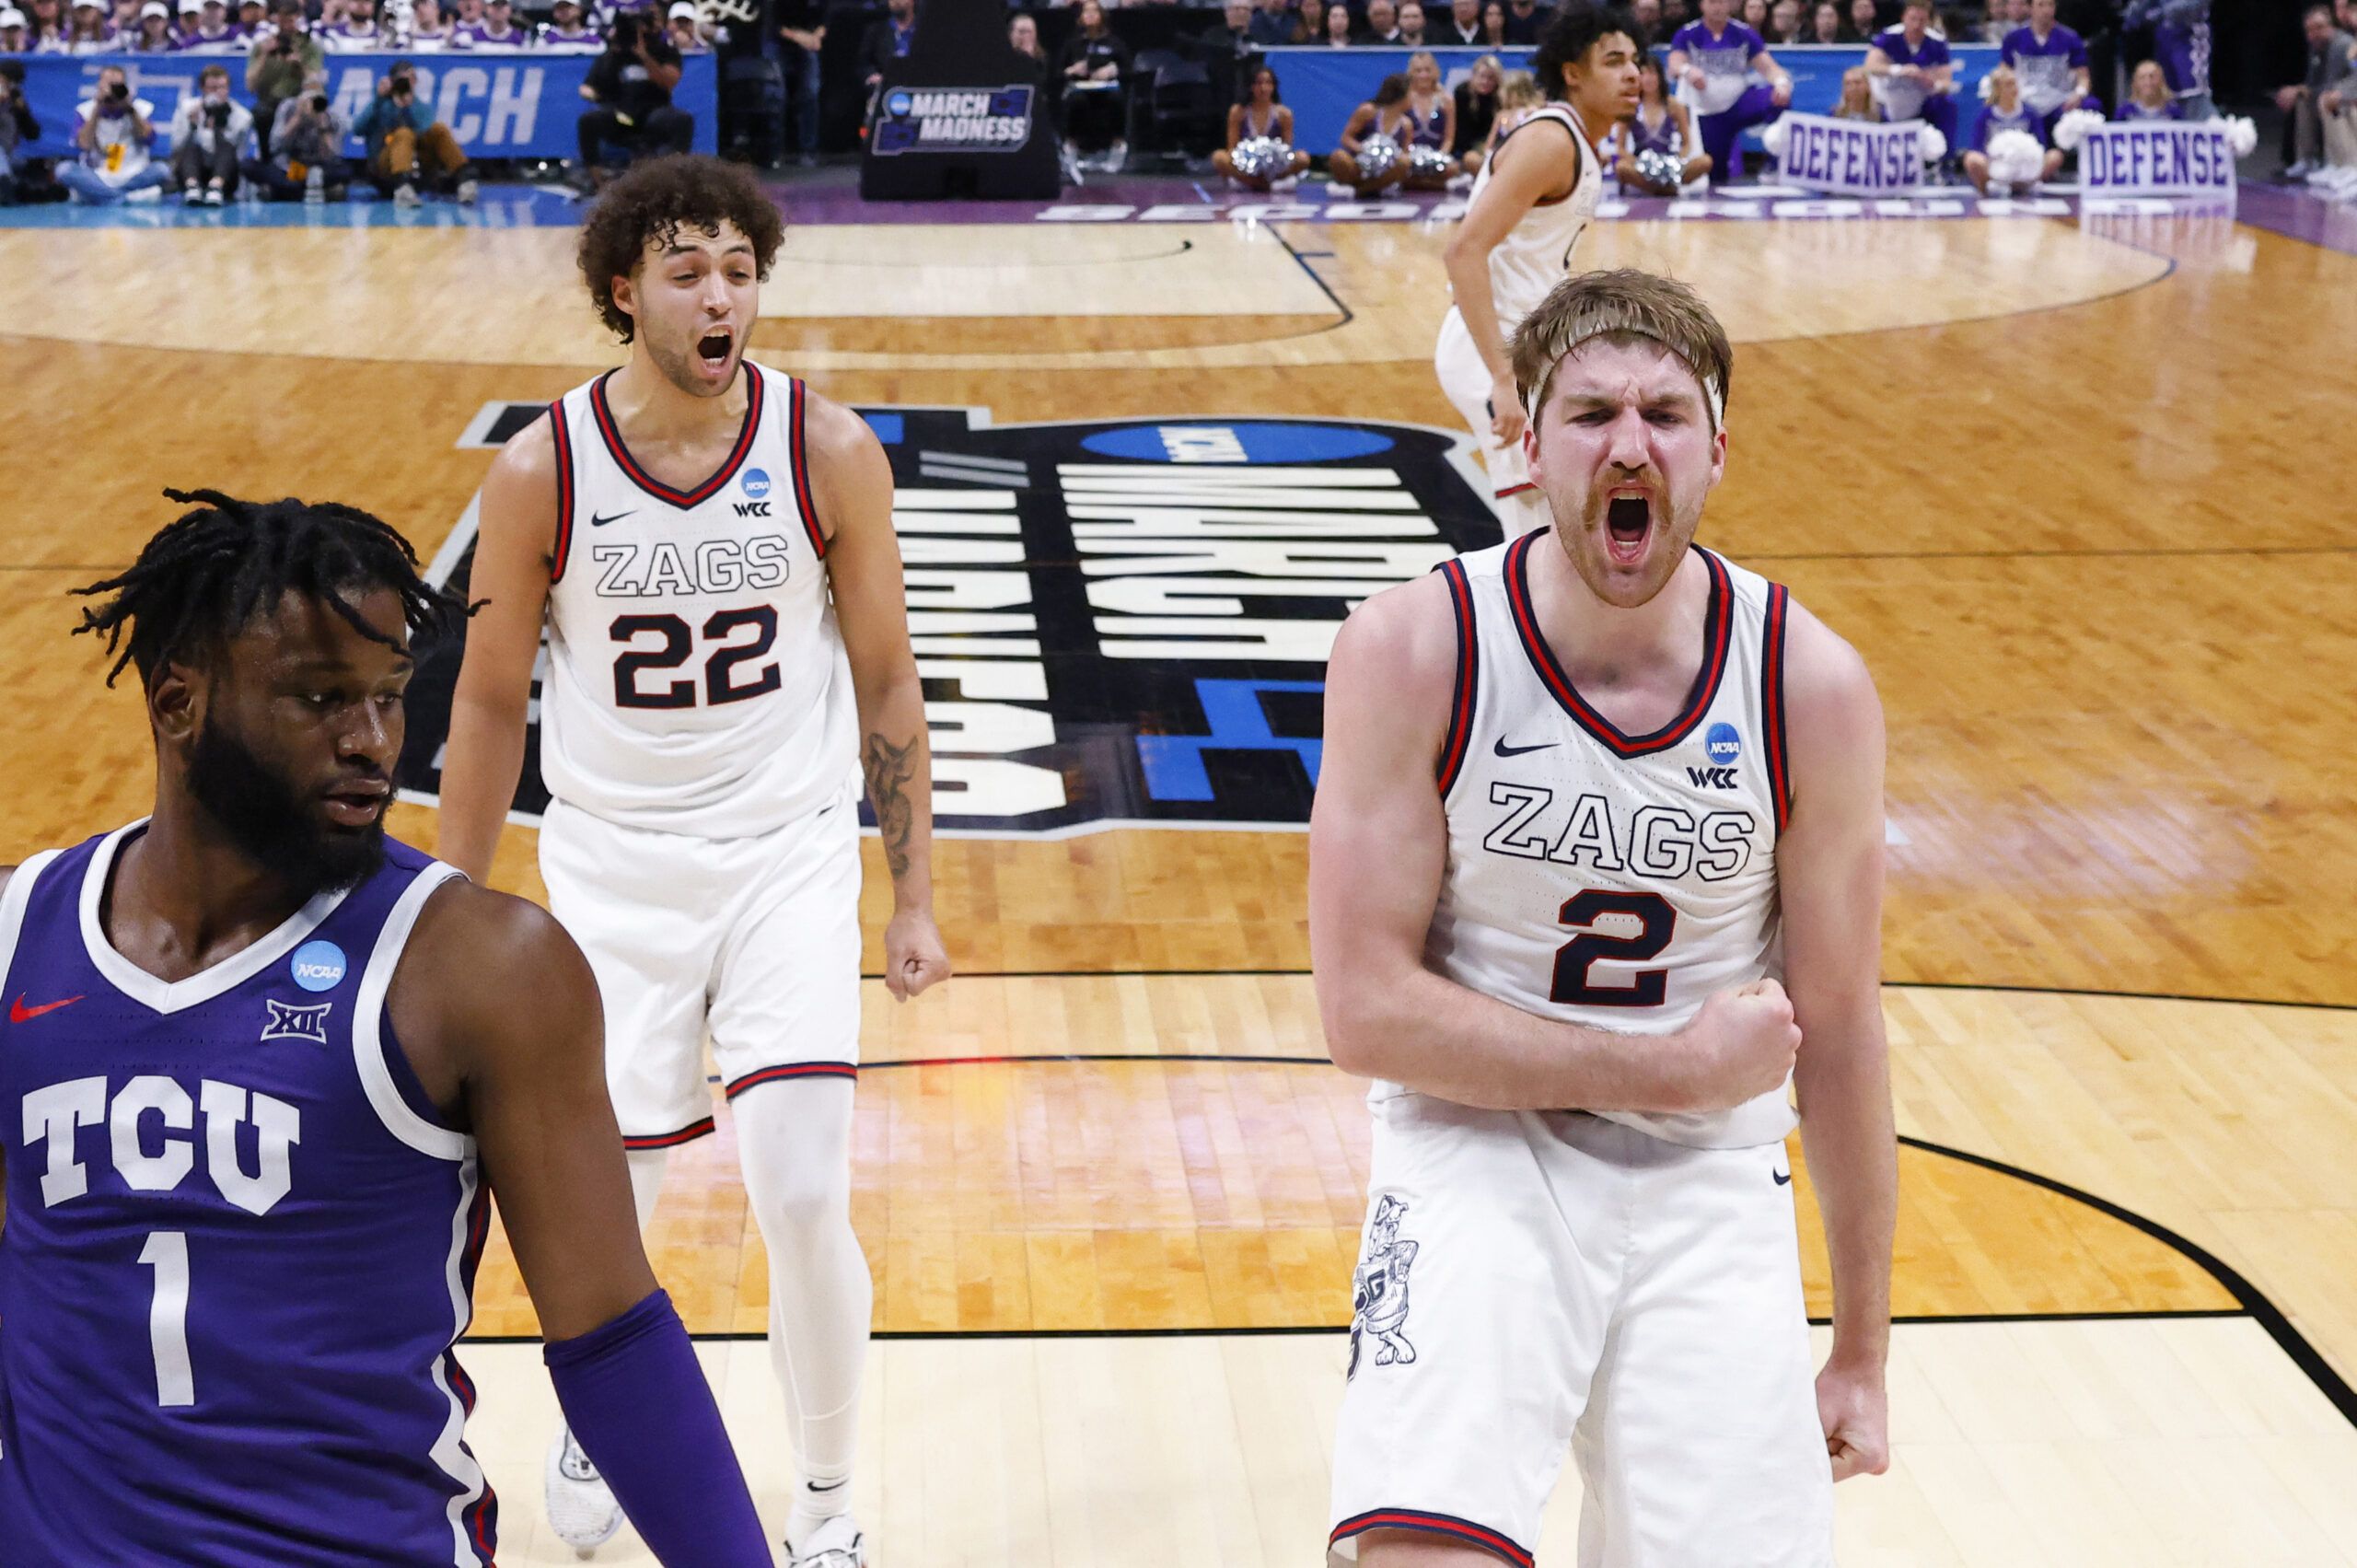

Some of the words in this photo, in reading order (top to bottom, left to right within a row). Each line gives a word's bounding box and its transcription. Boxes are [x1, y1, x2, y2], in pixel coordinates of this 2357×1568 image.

[910, 93, 991, 118] MARCH
[919, 117, 1026, 142] MADNESS
[1787, 122, 1918, 188] DEFENSE
[2088, 132, 2228, 186] DEFENSE
[733, 502, 772, 517] WCC
[746, 482, 770, 492] NCAA
[592, 535, 790, 598] ZAGS
[609, 604, 782, 710] 22
[1711, 741, 1739, 753] NCAA
[1686, 766, 1739, 789] WCC
[1483, 781, 1756, 882] ZAGS
[298, 963, 342, 980] NCAA
[1550, 888, 1678, 1006] 2
[22, 1074, 300, 1217] TCU
[137, 1230, 195, 1407] 1
